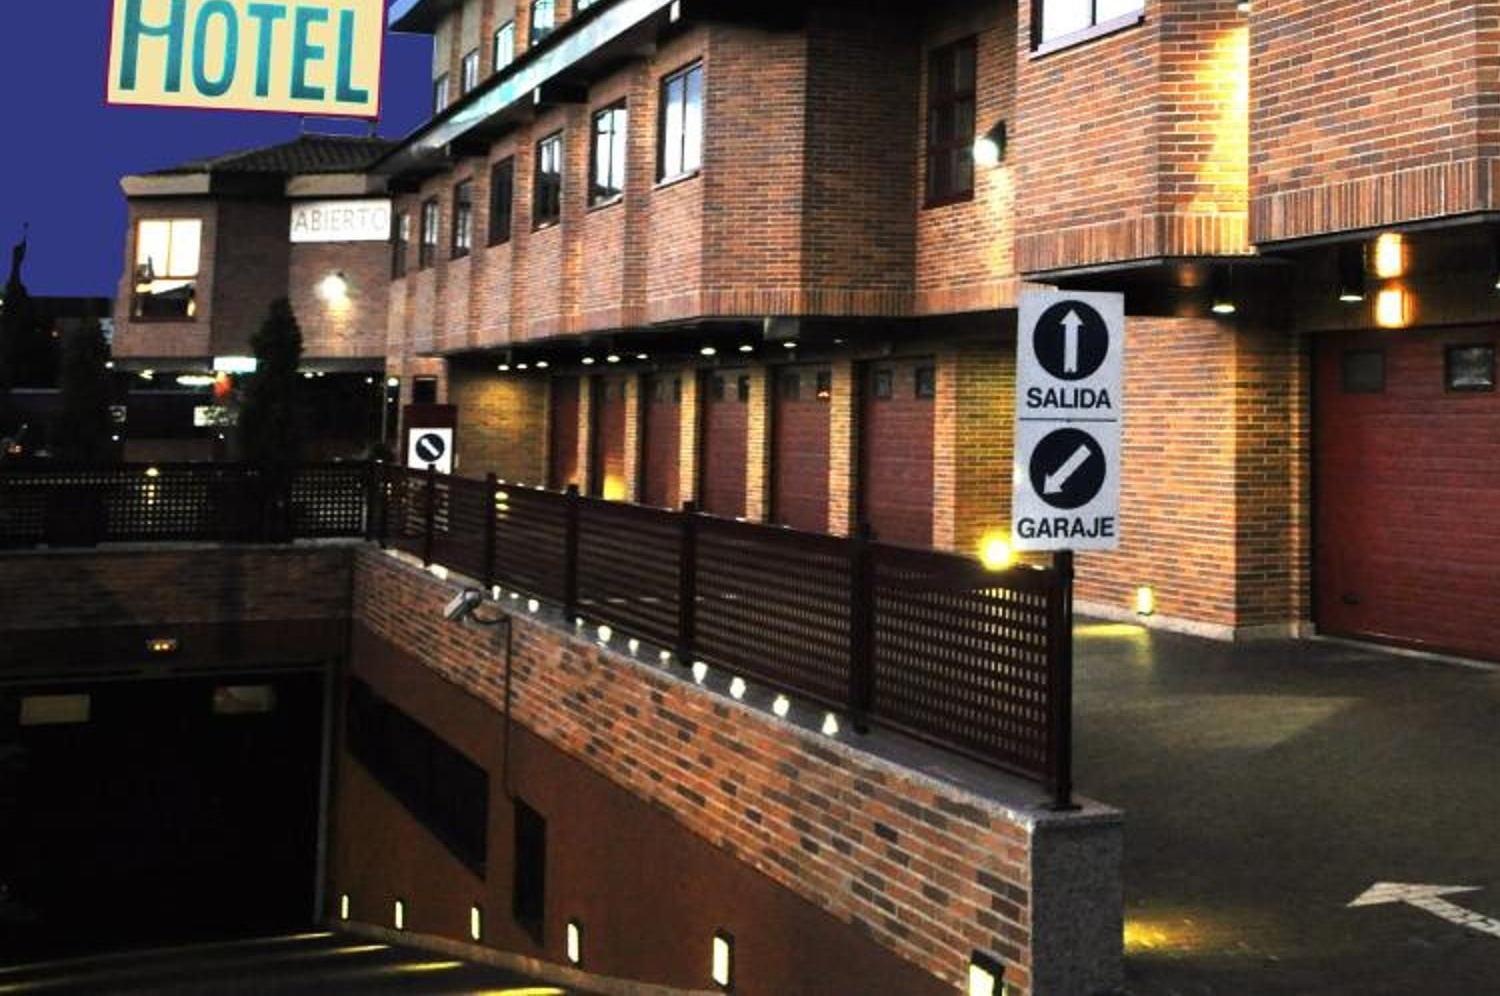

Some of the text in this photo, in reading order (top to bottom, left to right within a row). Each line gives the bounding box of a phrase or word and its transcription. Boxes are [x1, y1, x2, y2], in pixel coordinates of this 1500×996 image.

[293, 207, 386, 234] ABIERTO
[1026, 387, 1112, 409] SALIDA
[1017, 516, 1115, 538] GARAJE
